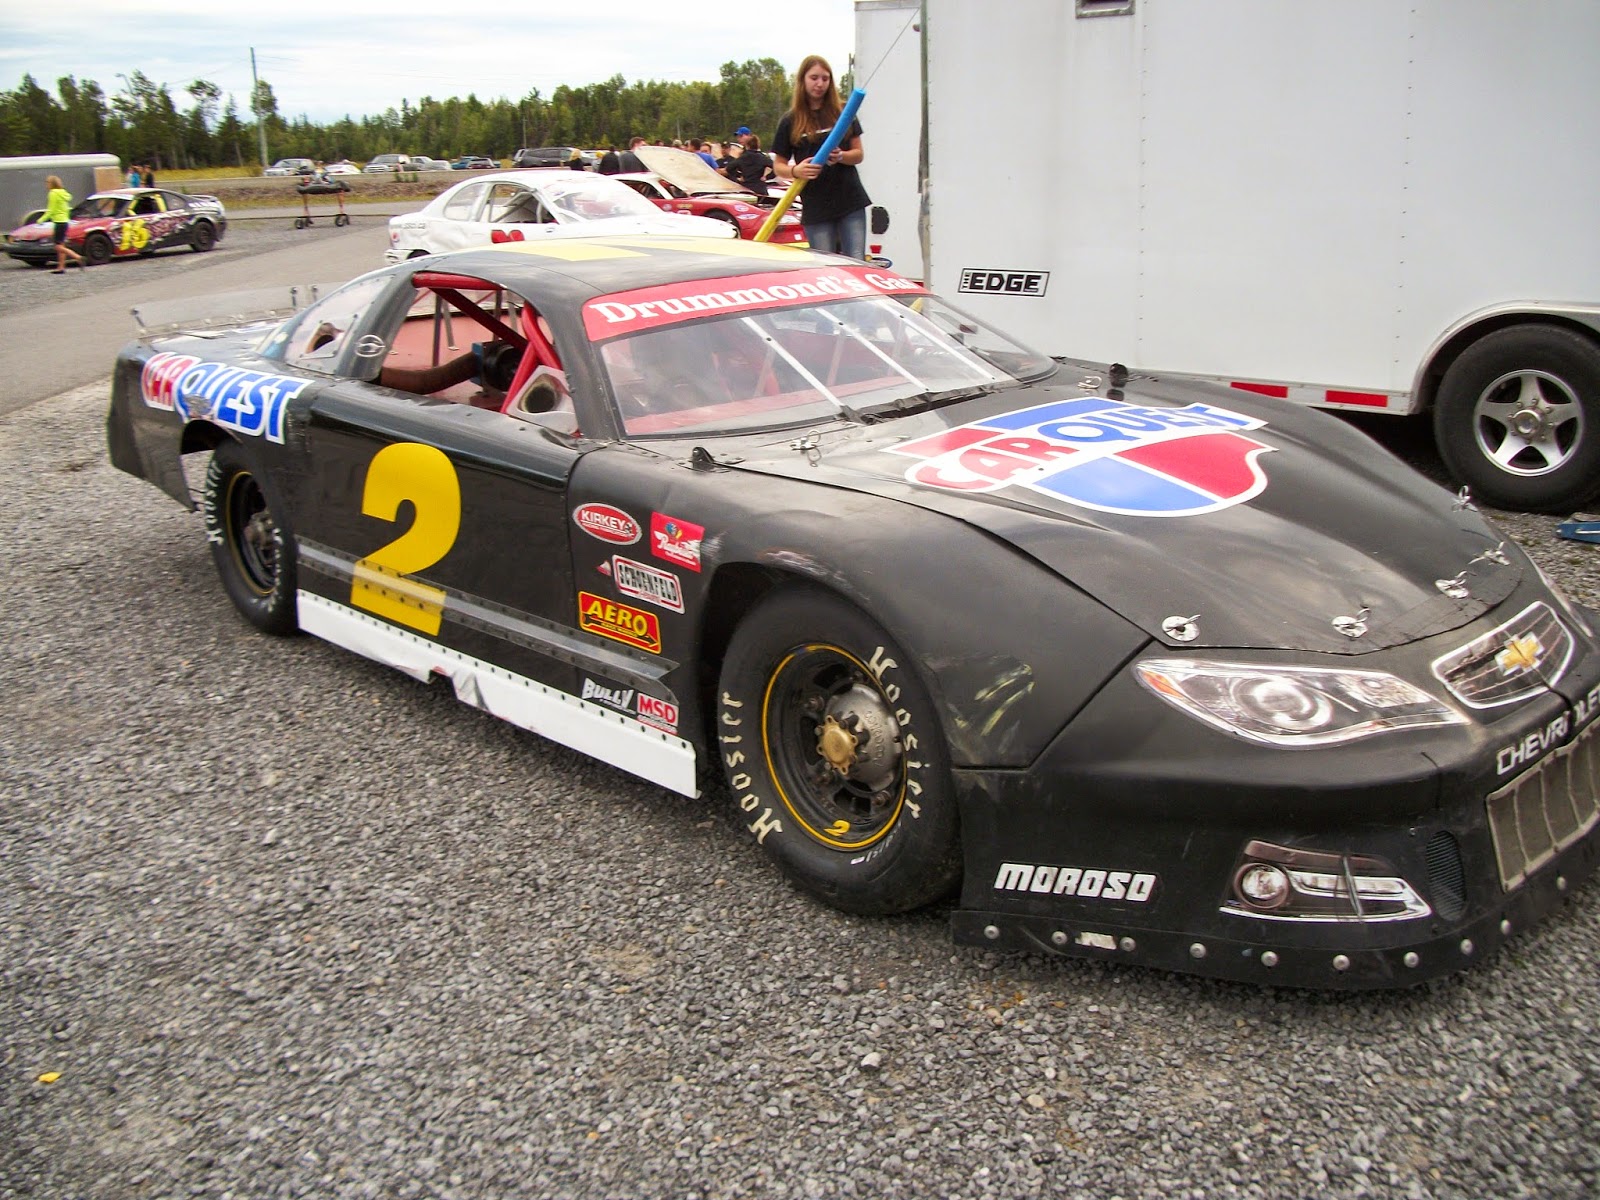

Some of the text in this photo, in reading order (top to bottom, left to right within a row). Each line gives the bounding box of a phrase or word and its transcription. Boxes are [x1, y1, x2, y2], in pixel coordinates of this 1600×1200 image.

[590, 275, 869, 323] Drummond's
[969, 272, 1042, 293] EDGE
[351, 442, 461, 636] 2
[581, 509, 626, 532] KIRKEY
[586, 600, 648, 637] AERO
[582, 677, 634, 709] BULLY
[639, 693, 677, 725] MSD
[868, 646, 931, 819] Hoosier
[1496, 683, 1600, 776] CHEVROLE
[719, 691, 783, 844] Hoosier
[824, 819, 850, 837] 2
[993, 862, 1157, 902] MOROSO
